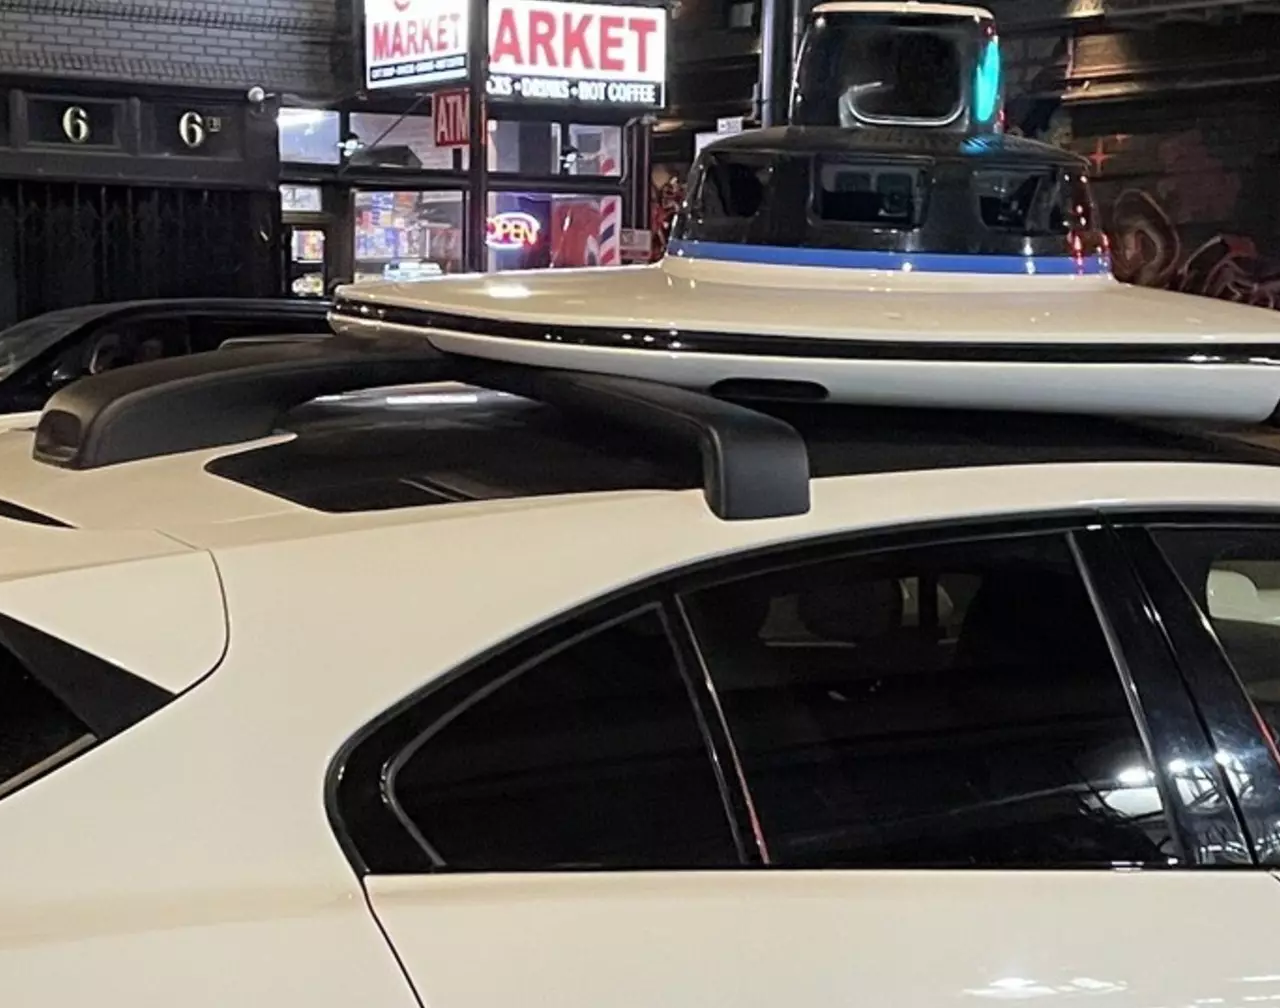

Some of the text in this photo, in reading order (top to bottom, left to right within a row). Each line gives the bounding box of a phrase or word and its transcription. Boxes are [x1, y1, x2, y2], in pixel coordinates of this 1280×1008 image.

[373, 13, 461, 62] MARKET
[487, 6, 657, 73] ARKET
[578, 80, 607, 101] HOT
[608, 82, 656, 103] COFFEE
[62, 106, 89, 143] 6
[179, 111, 204, 148] 6
[437, 94, 469, 143] ATM
[487, 217, 538, 246] OPEN
